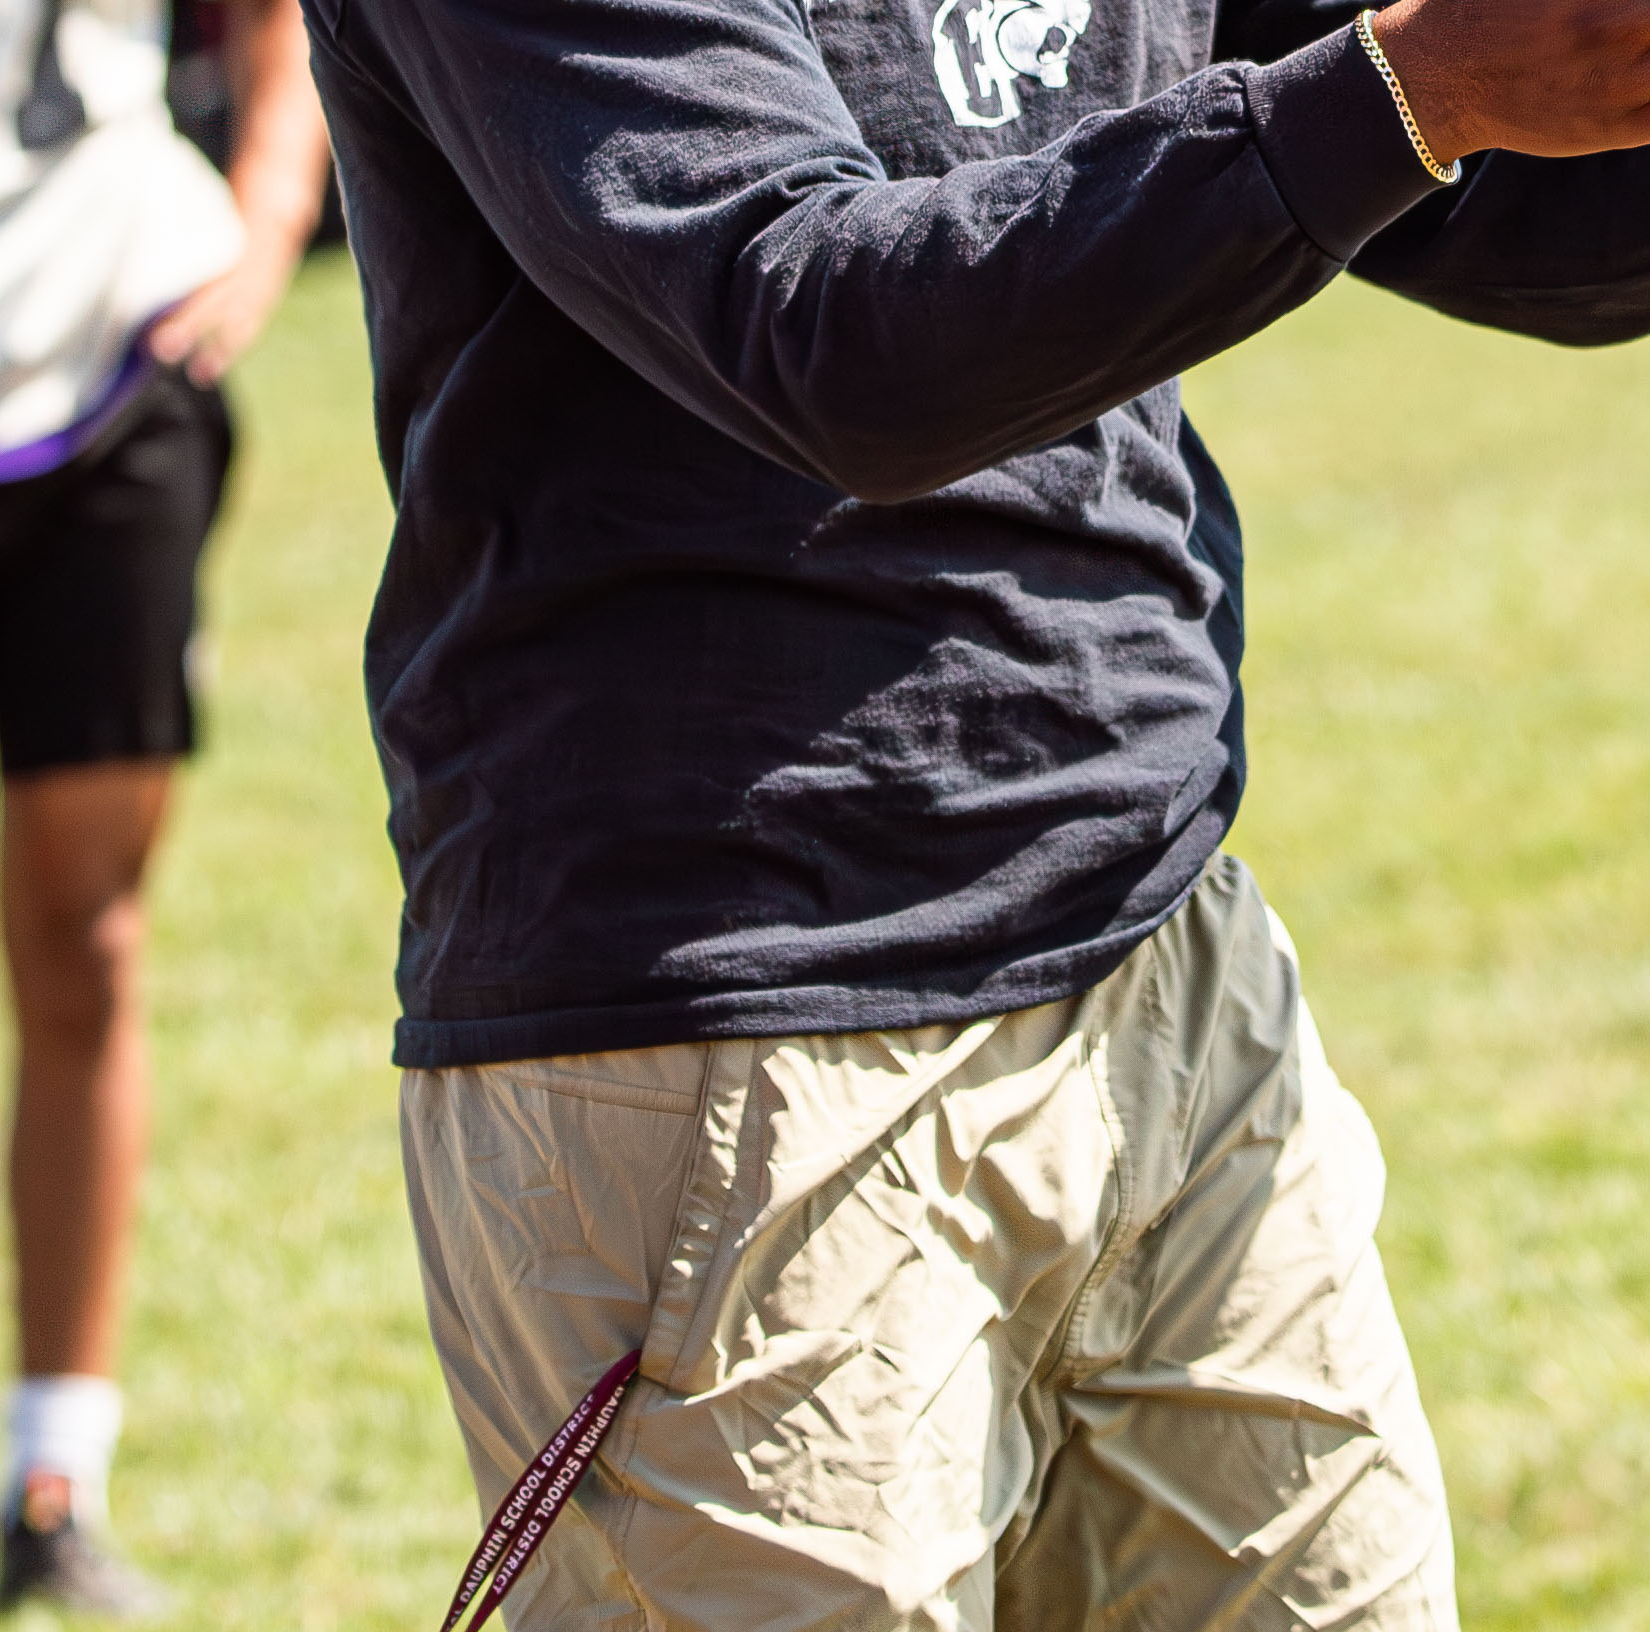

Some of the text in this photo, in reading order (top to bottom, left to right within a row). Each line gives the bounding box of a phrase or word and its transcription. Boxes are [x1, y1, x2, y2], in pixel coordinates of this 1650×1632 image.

[459, 1394, 593, 1604] DAUPHIN SCHOOL DISTRICT
[492, 1384, 625, 1595] DAUPHIN SCHOOL DISTRICT
